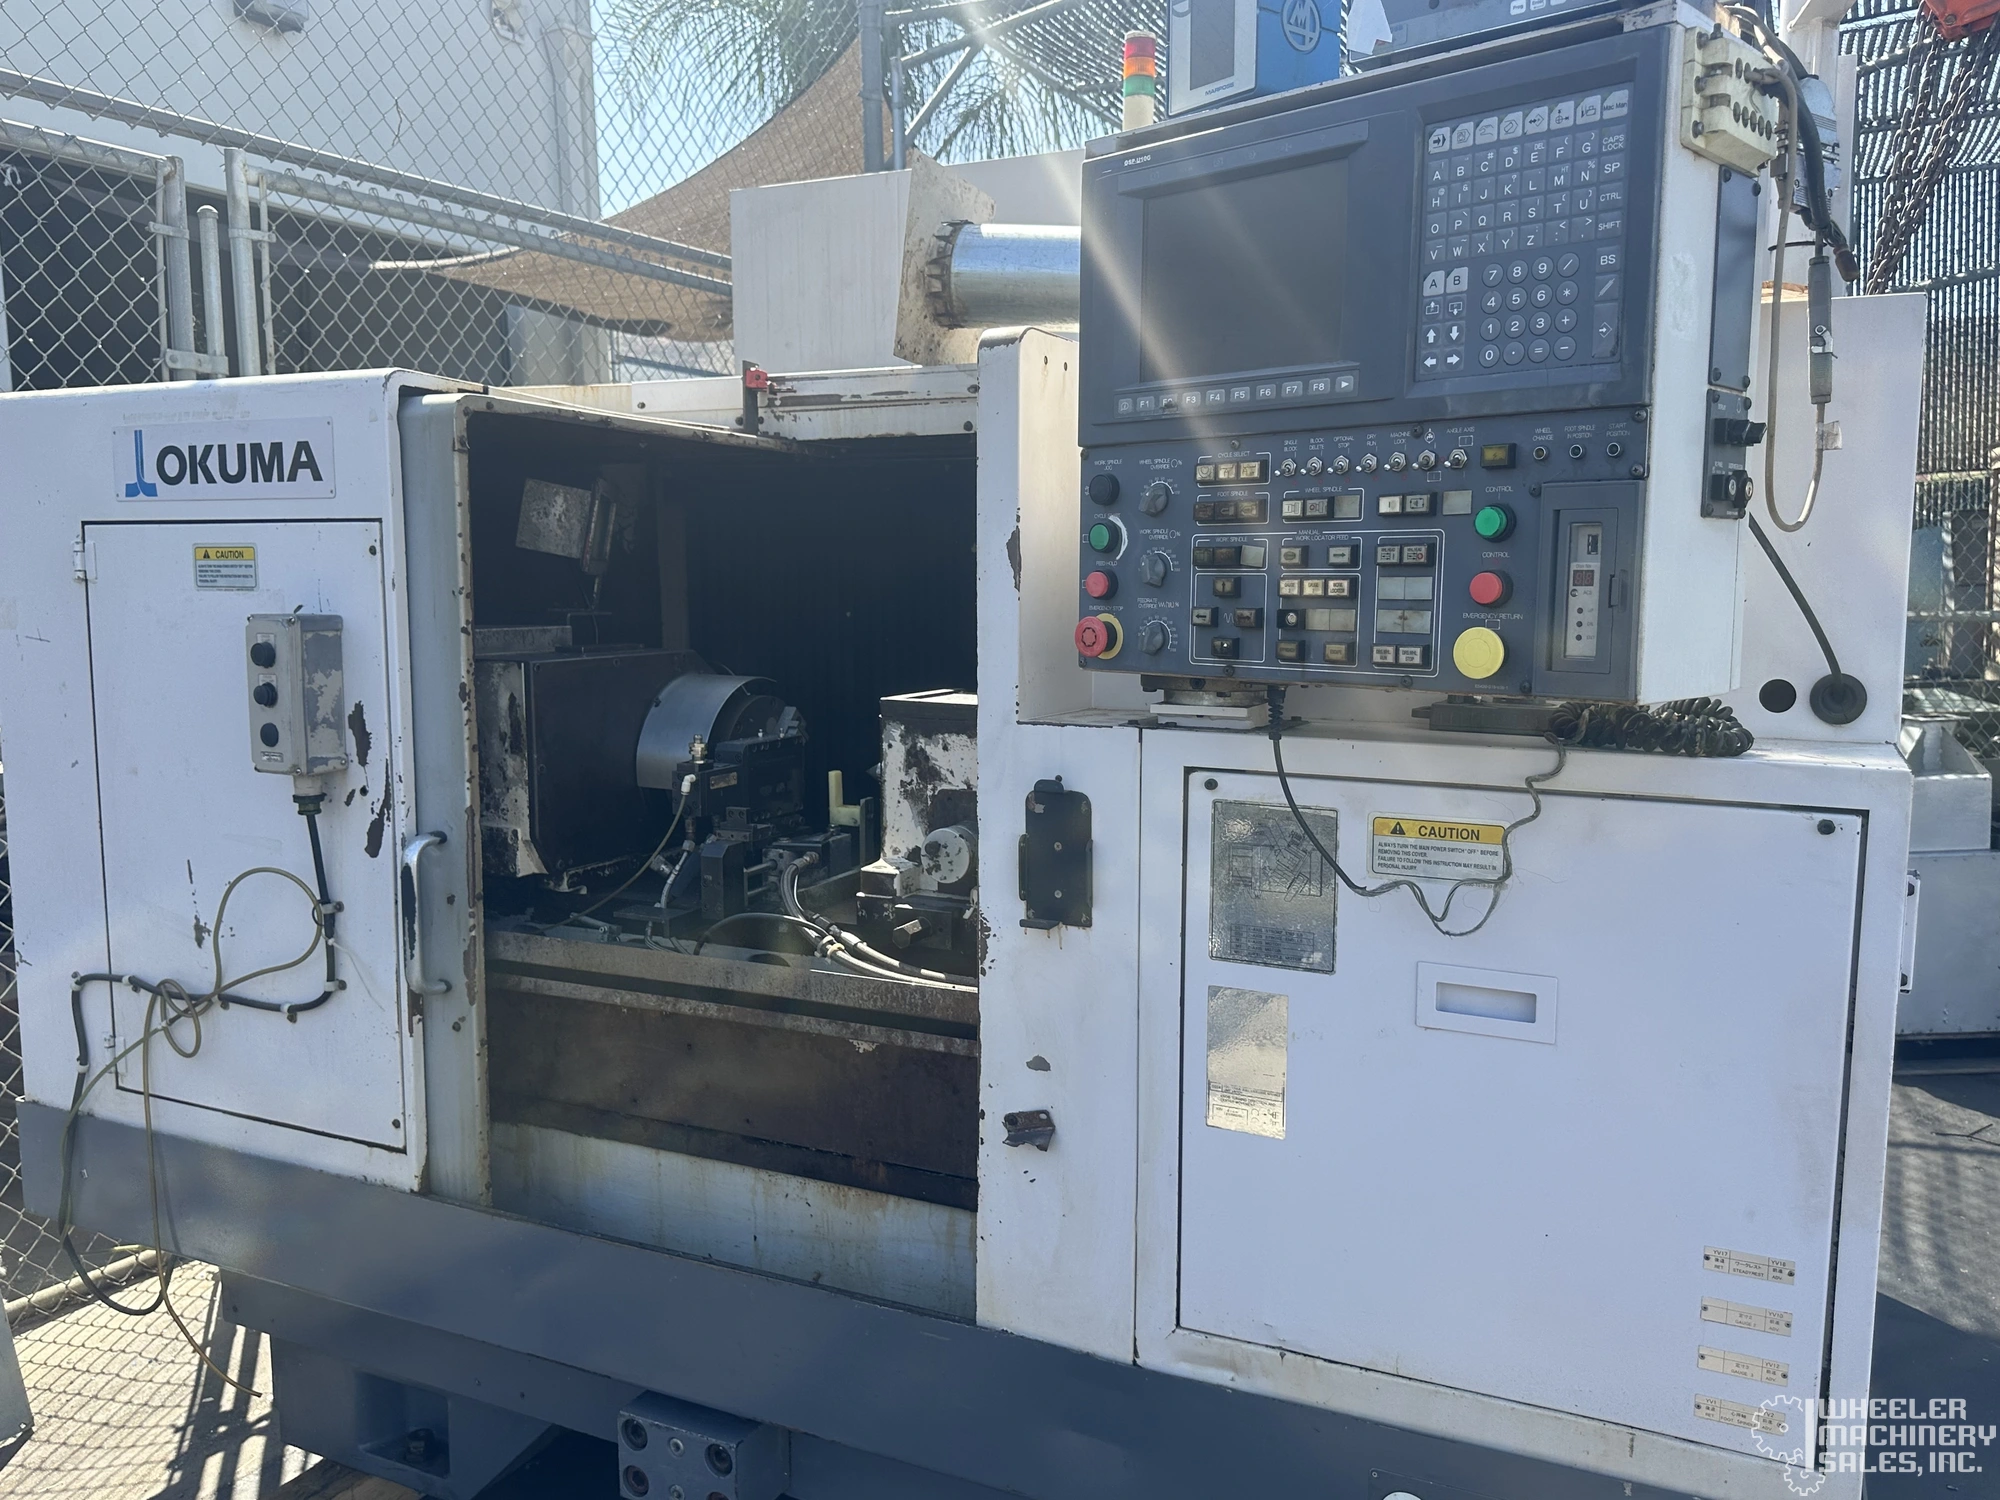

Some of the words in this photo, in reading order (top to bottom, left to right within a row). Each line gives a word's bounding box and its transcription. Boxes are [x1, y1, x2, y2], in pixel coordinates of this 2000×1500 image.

[1205, 82, 1234, 96] MARPOSS
[1602, 135, 1624, 144] CAPS
[1582, 143, 1590, 153] G
[1602, 142, 1624, 152] LOCK
[1531, 152, 1538, 163] E
[1556, 148, 1564, 158] F
[1481, 162, 1488, 171] C
[1506, 157, 1513, 167] D
[1457, 167, 1464, 176] B
[1604, 162, 1620, 174] SP
[1433, 171, 1441, 181] A
[1554, 176, 1563, 186] M
[1581, 171, 1589, 181] N
[1505, 185, 1512, 195] K
[1529, 181, 1536, 190] L
[1458, 194, 1461, 203] I
[1480, 190, 1487, 199] J
[1600, 192, 1621, 202] CTRL
[1432, 198, 1439, 207] H
[1580, 199, 1588, 209] U
[1528, 208, 1535, 218] S
[1554, 204, 1562, 213] T
[1479, 216, 1486, 226] Q
[1504, 212, 1511, 222] R
[1431, 224, 1439, 233] O
[1455, 220, 1462, 230] P
[1598, 221, 1621, 231] SHIFT
[1502, 239, 1509, 249] Y
[1527, 236, 1534, 246] Z
[1453, 247, 1462, 257] W
[1478, 243, 1485, 253] X
[1431, 250, 1437, 260] V
[1601, 255, 1616, 265] BS
[1513, 266, 1521, 277] 8
[1539, 263, 1547, 273] 9
[1489, 270, 1497, 280] 7
[1430, 279, 1437, 289] A
[1454, 276, 1460, 285] B
[1512, 294, 1520, 304] 5
[1537, 290, 1545, 301] 6
[1487, 297, 1495, 307] 4
[1511, 321, 1519, 331] 2
[1536, 318, 1544, 328] 3
[1488, 324, 1492, 333] 1
[1485, 351, 1493, 360] 0
[1260, 388, 1271, 396] F6
[1286, 386, 1297, 394] F7
[1313, 383, 1324, 391] F8
[1210, 394, 1220, 402] F4
[1235, 391, 1245, 399] F5
[156, 441, 323, 486] OKUMA
[216, 550, 244, 559] CAUTION
[1418, 825, 1480, 841] CAUTION
[1378, 848, 1400, 856] REMOVING
[1378, 862, 1400, 870] PERSONAL
[1433, 860, 1462, 868] INSTRUCTION
[1721, 1415, 1733, 1423] FOOT
